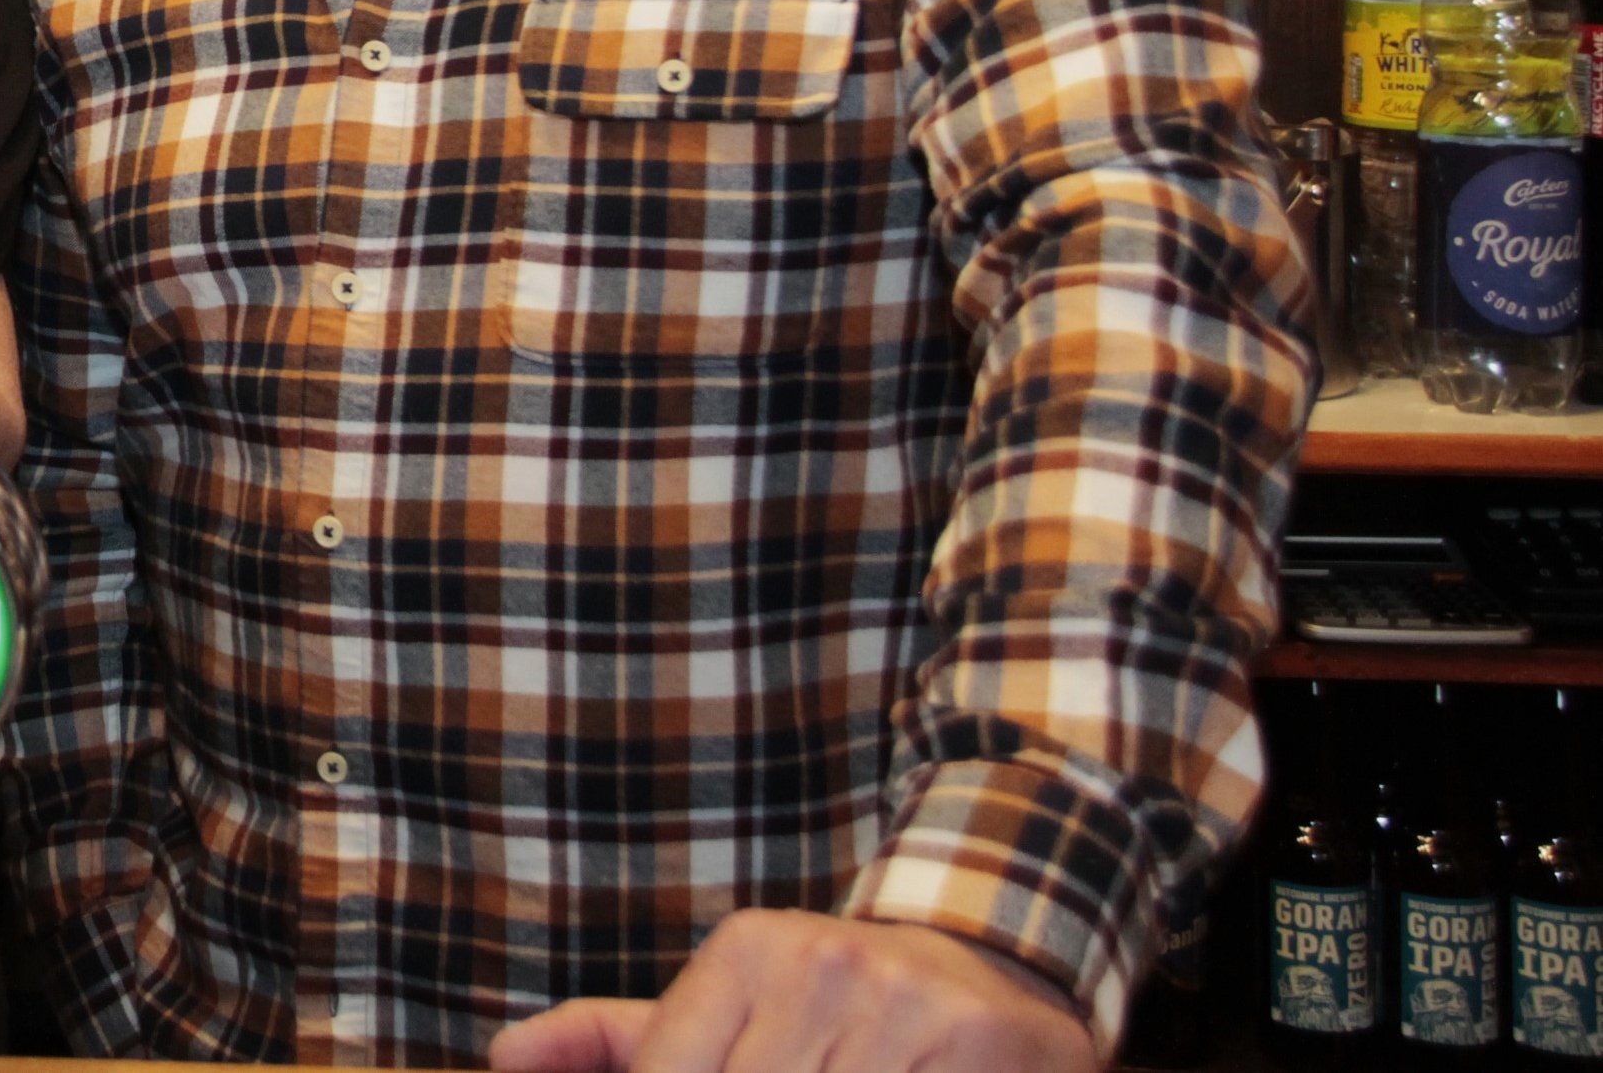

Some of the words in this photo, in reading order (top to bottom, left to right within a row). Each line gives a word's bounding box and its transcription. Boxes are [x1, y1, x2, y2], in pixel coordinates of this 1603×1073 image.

[1377, 56, 1430, 73] WHIT
[1411, 38, 1422, 54] R
[1380, 83, 1426, 92] LEMON
[1472, 218, 1582, 278] Royal
[1483, 290, 1528, 320] SODA
[1277, 927, 1340, 965] IPA
[1516, 916, 1603, 953] GORA
[1347, 932, 1367, 1007] ZERO
[1408, 941, 1475, 978] IPA
[1517, 946, 1588, 987] IPA
